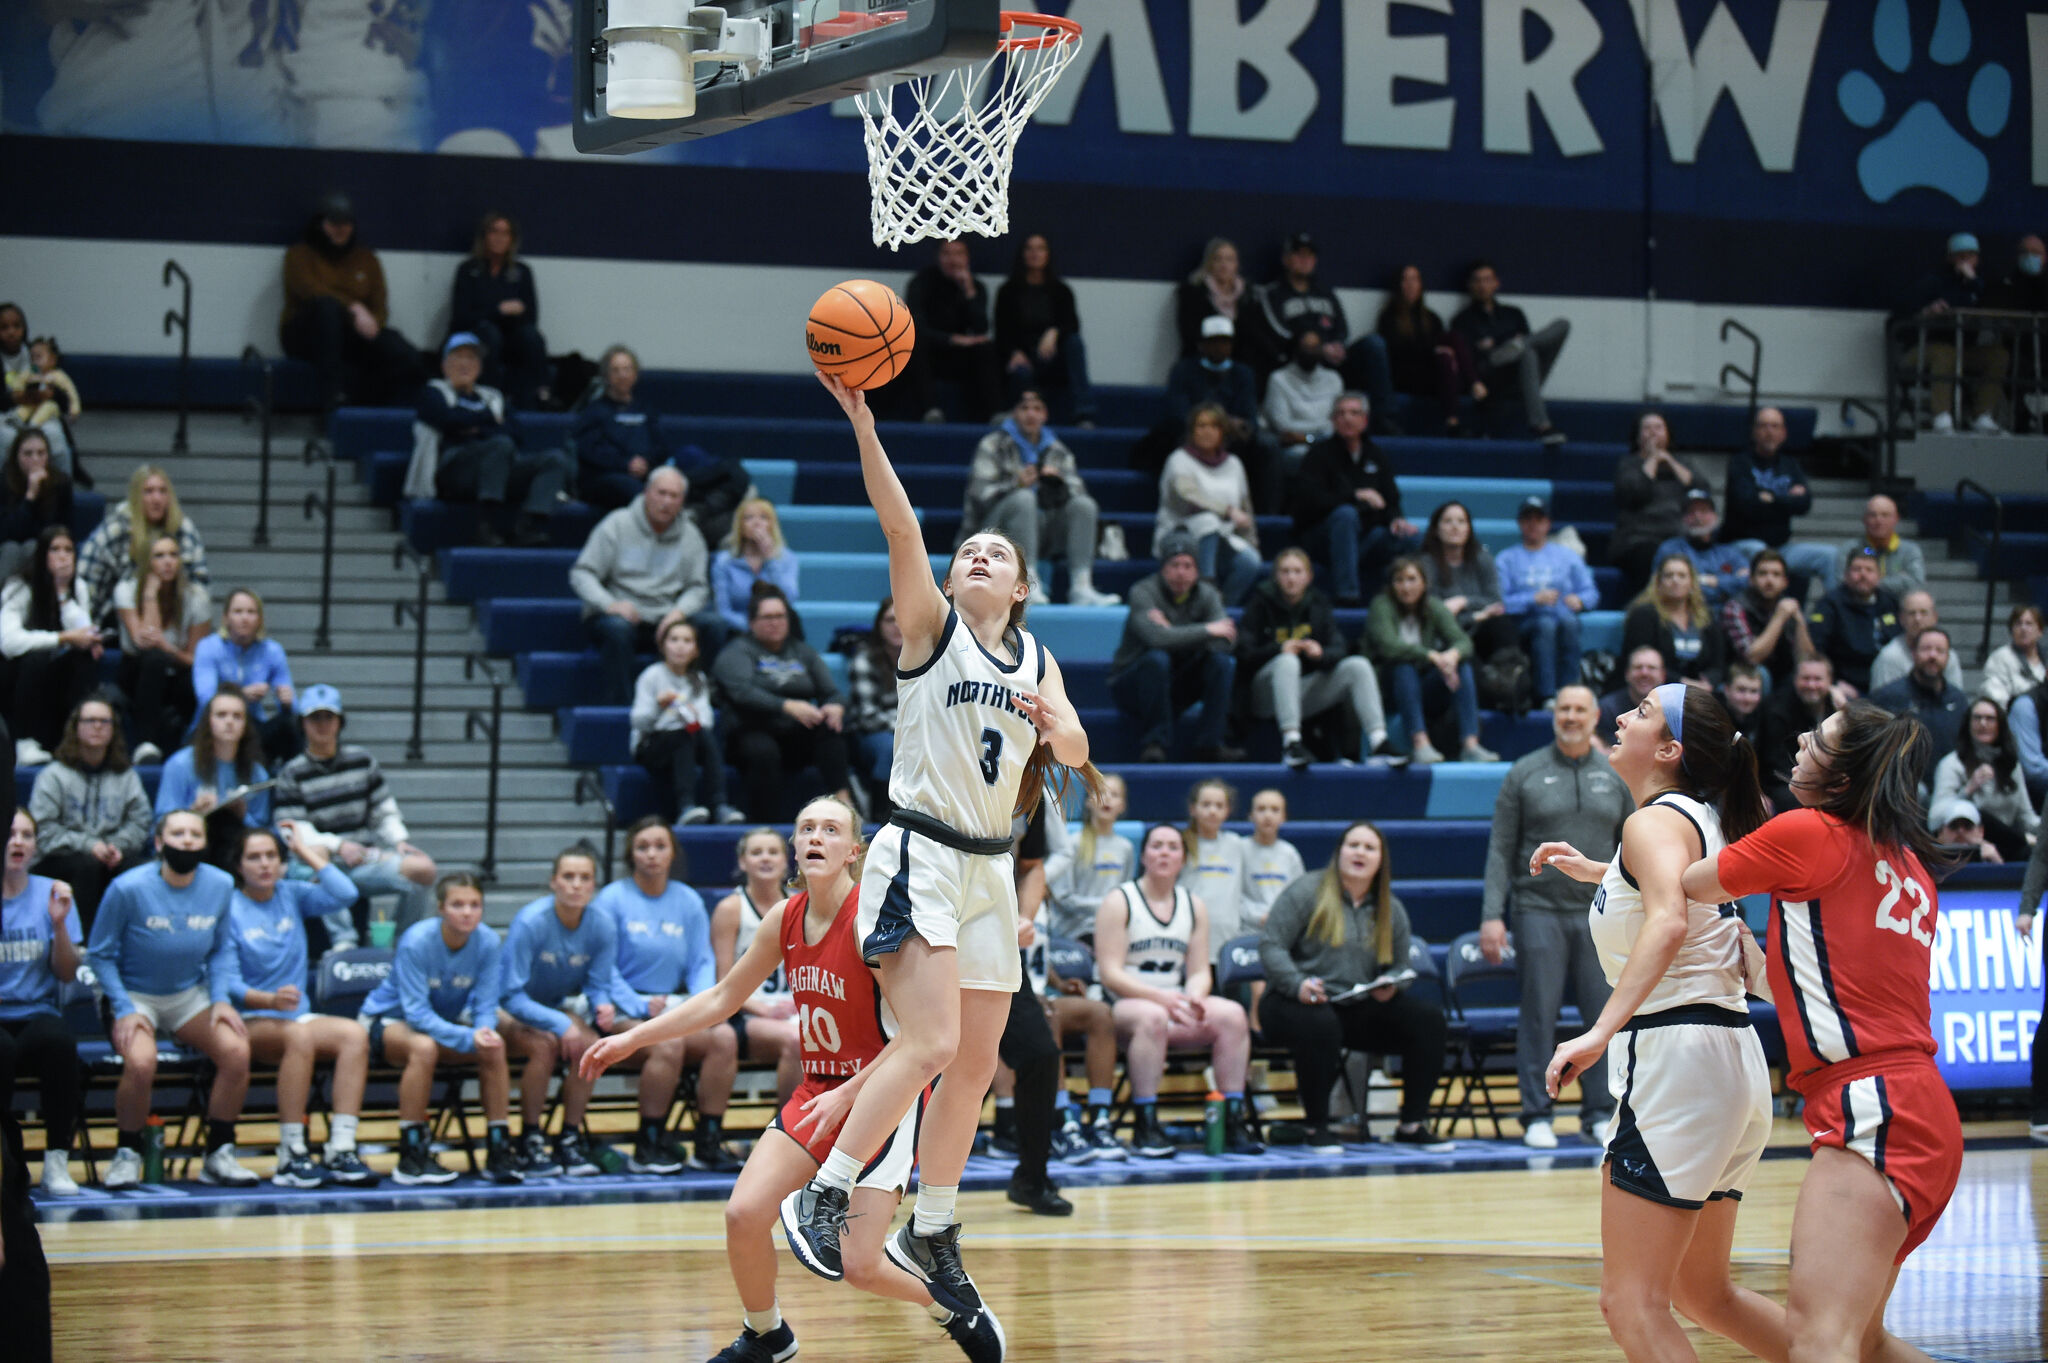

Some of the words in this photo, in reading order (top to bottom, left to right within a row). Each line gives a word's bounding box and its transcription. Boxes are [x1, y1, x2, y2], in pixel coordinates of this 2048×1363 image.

[806, 329, 841, 355] ilson
[946, 681, 1034, 725] NORTHWO
[979, 726, 1003, 786] 3
[1875, 860, 1932, 947] 22
[789, 966, 846, 1001] AGINAW
[800, 1004, 841, 1053] 10
